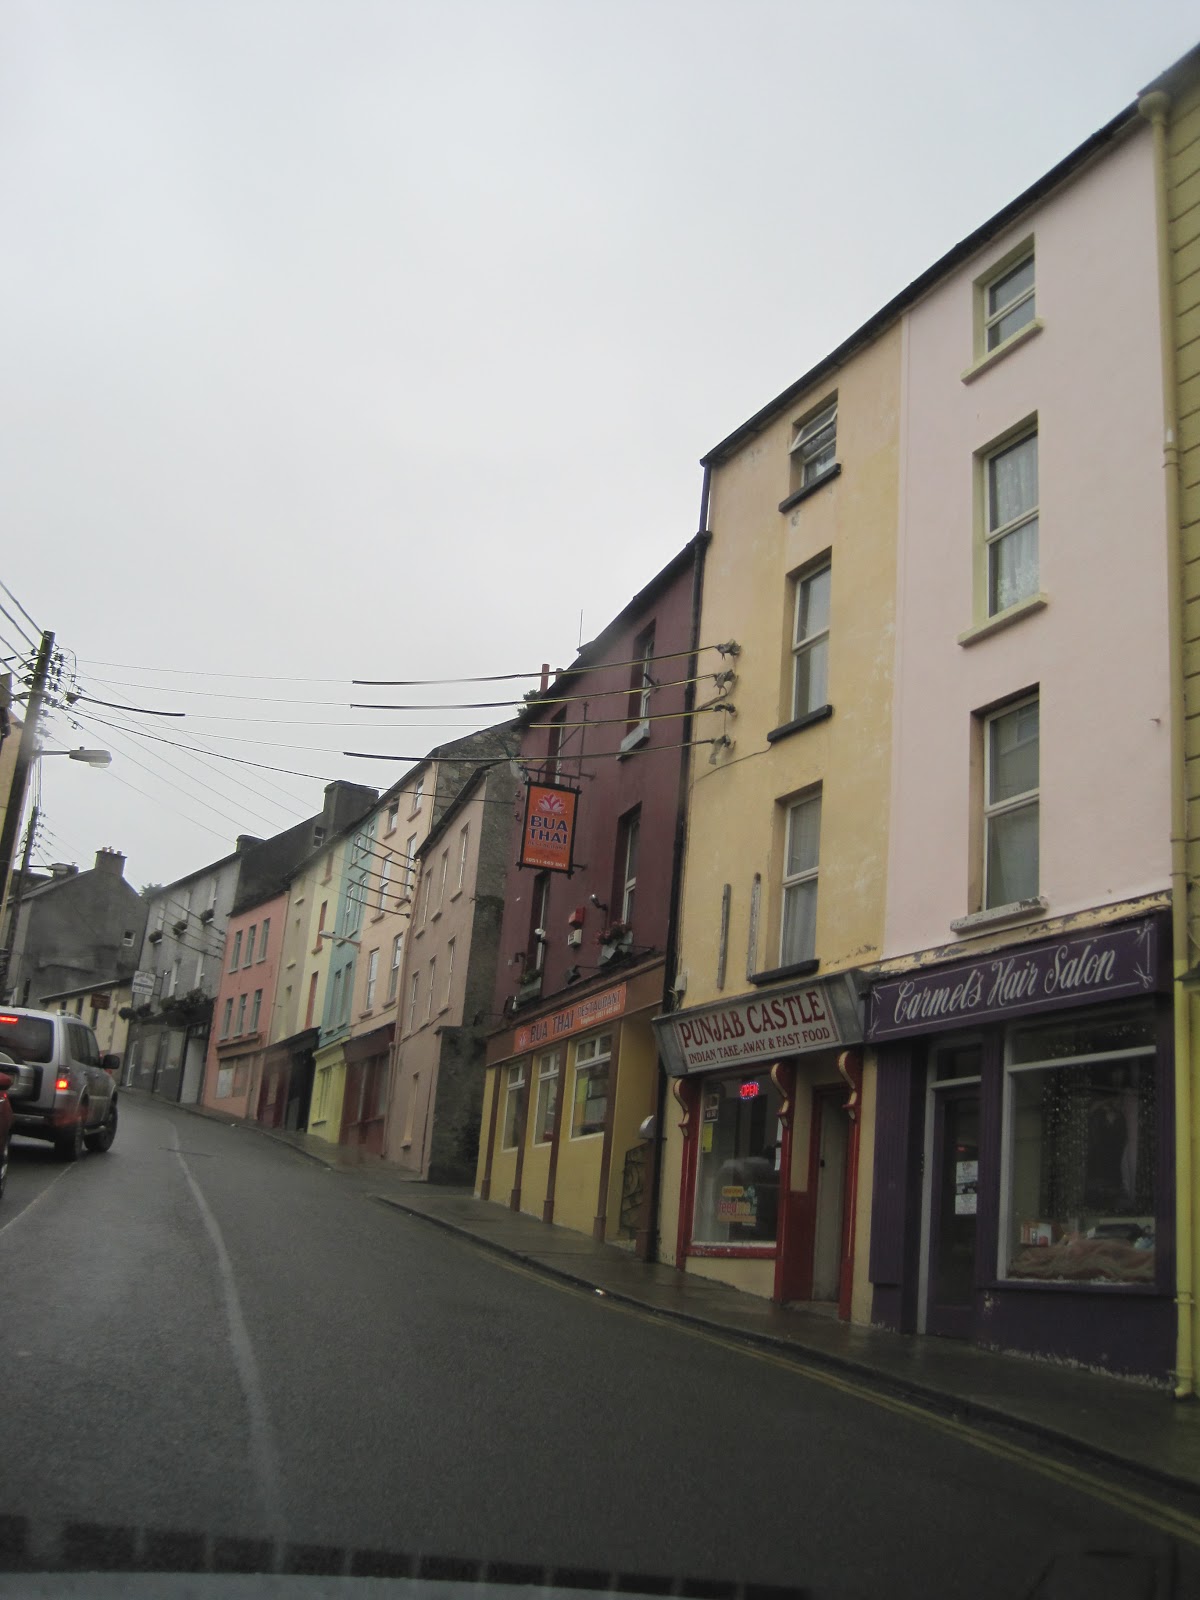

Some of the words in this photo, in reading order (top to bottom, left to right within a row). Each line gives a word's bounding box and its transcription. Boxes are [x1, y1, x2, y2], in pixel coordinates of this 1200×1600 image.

[529, 827, 568, 845] THAI
[530, 815, 568, 832] BUA
[894, 969, 984, 1024] Carmel's
[987, 958, 1039, 1007] Hair
[1044, 944, 1116, 993] Salon
[530, 1021, 548, 1043] BUA
[552, 1010, 574, 1035] THAI
[577, 990, 622, 1017] RESTAURANT
[678, 1010, 745, 1048] PUNJAB
[746, 991, 826, 1034] CASTLE
[688, 1048, 717, 1065] INDIAN
[717, 1039, 766, 1058] TAKE-AWAY
[768, 1037, 776, 1049] &
[777, 1032, 801, 1048] FAST
[802, 1027, 830, 1042] FOOD
[740, 1083, 758, 1097] OPEN
